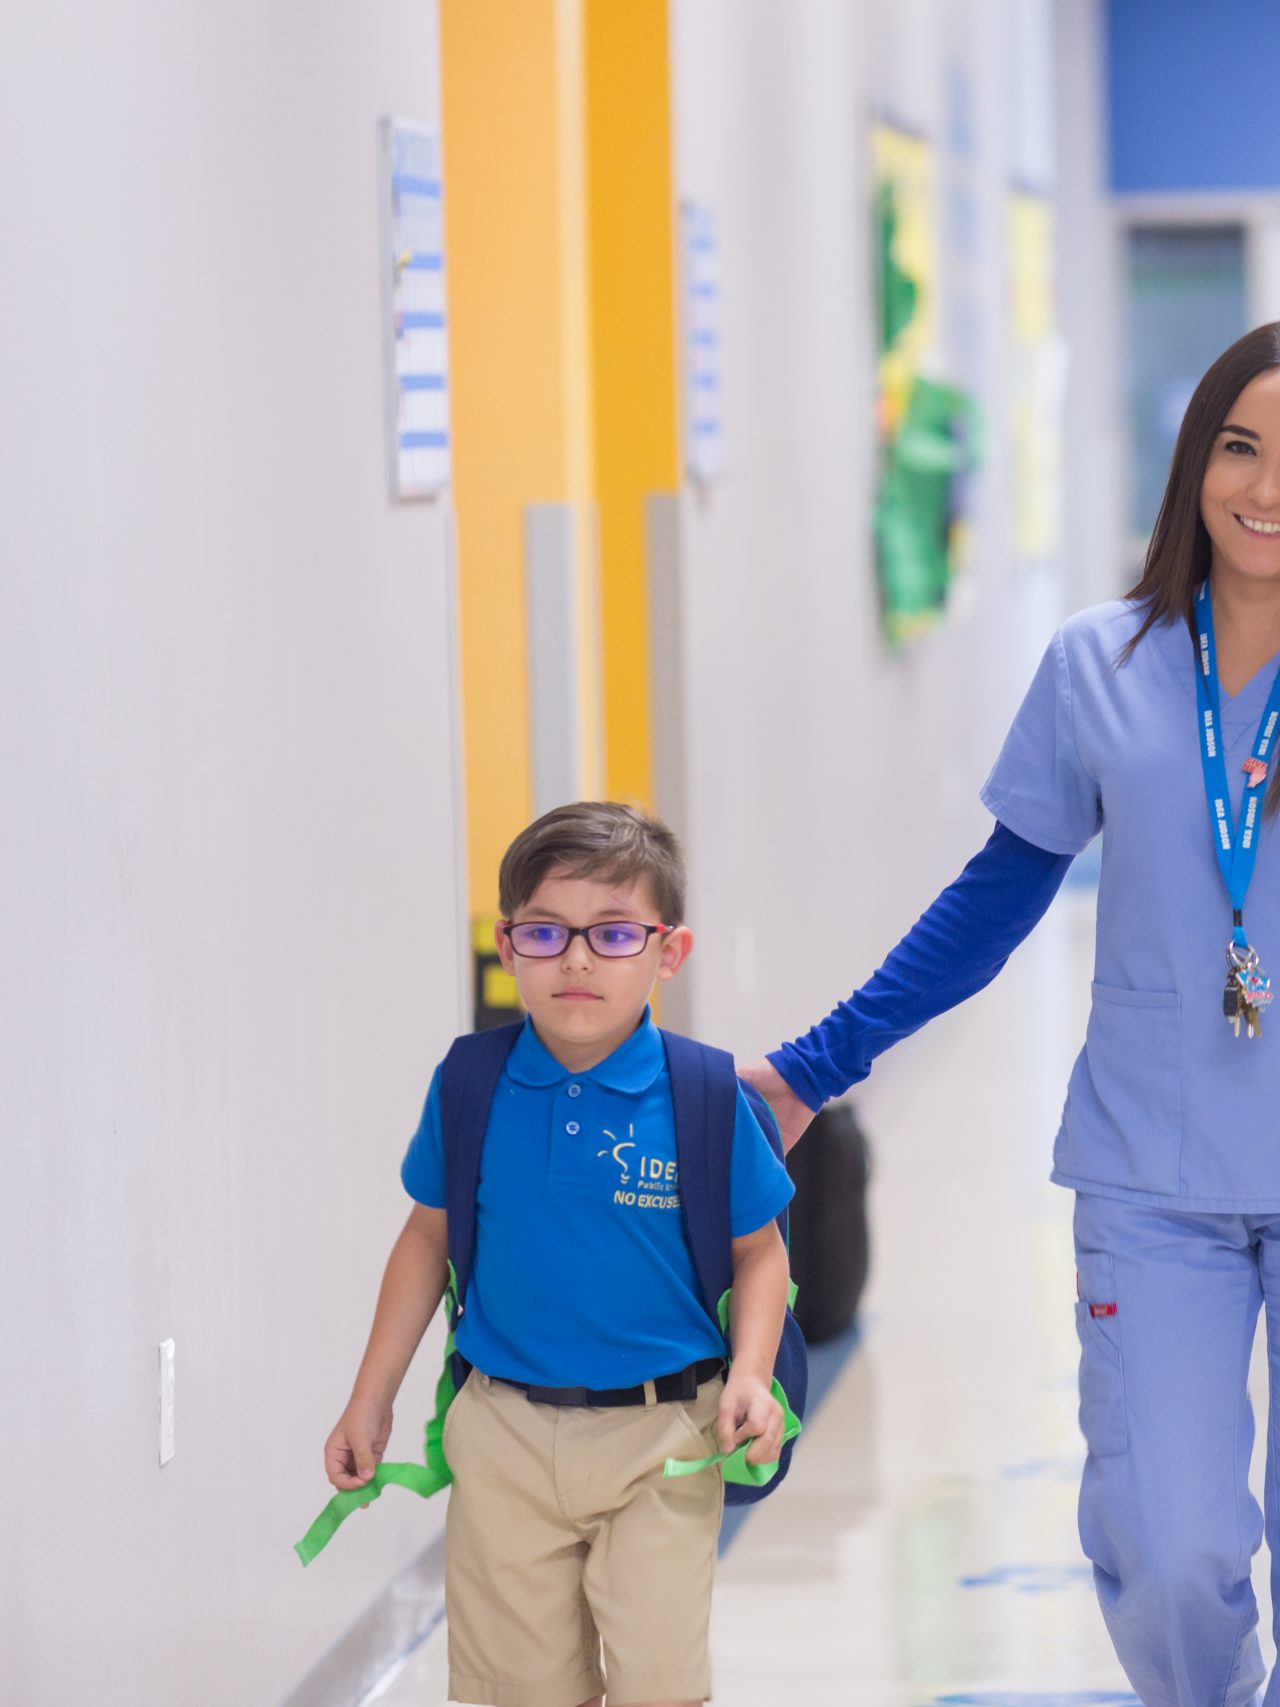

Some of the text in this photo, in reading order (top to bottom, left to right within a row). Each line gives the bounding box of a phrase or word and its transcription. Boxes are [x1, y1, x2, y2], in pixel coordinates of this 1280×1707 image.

[1204, 710, 1216, 758] IDEA JUDSON
[1258, 711, 1279, 756] IDEA JUDSON
[1214, 799, 1231, 850] IDEA JUDSON
[1242, 796, 1258, 849] IDEA JUDSON
[640, 1156, 679, 1182] IDE
[613, 1190, 636, 1206] NO
